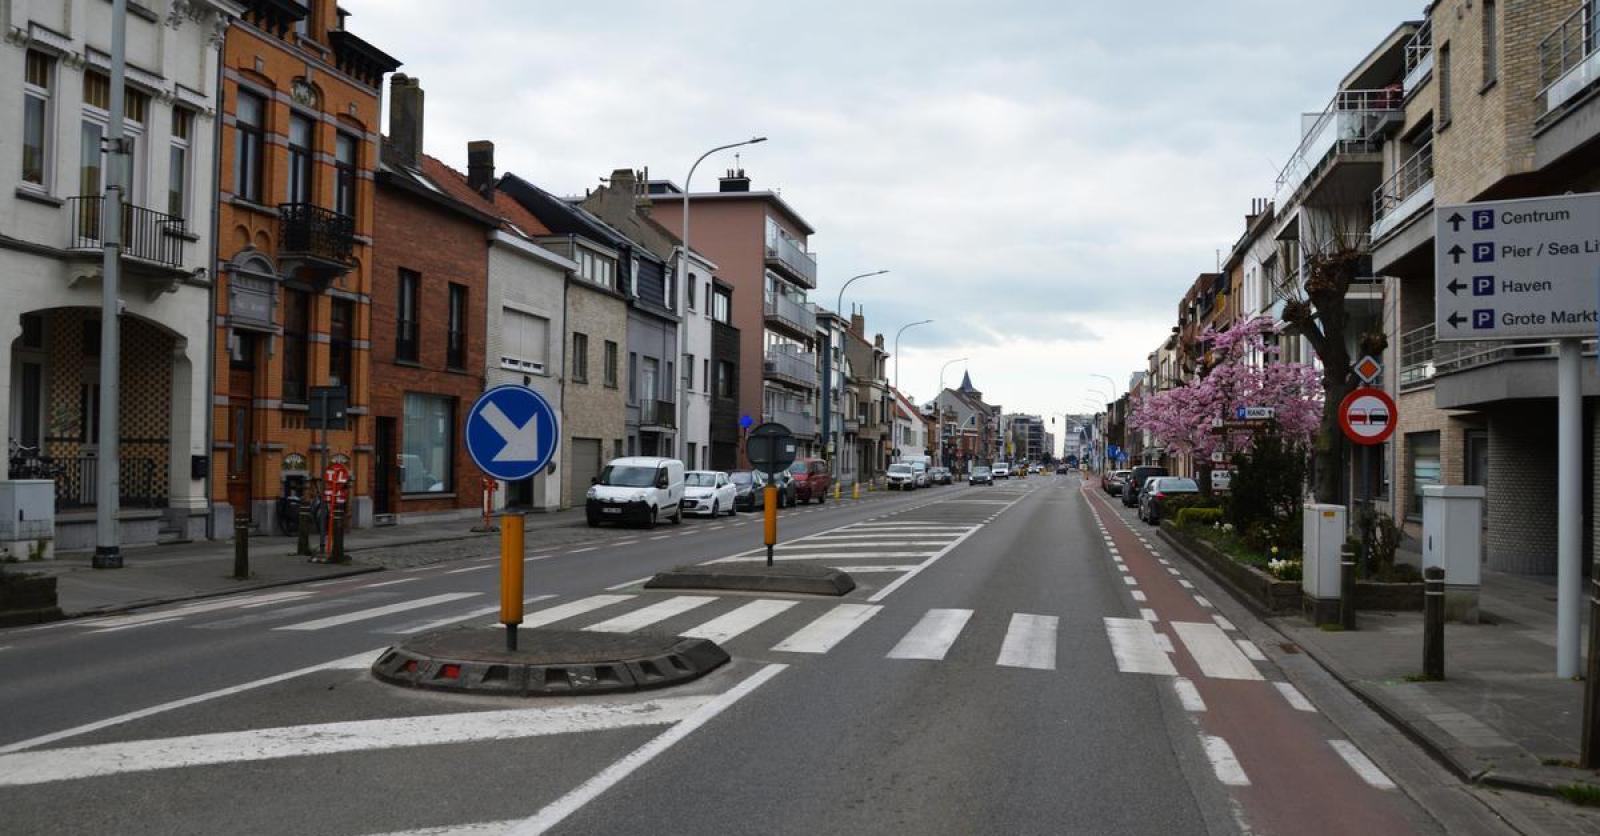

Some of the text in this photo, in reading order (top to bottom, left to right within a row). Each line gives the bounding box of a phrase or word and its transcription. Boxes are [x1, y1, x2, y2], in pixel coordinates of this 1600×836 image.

[1502, 210, 1569, 224] Centrum
[1502, 245, 1533, 258] Pier
[1537, 243, 1545, 256] /
[1548, 242, 1579, 256] Sea
[1584, 239, 1600, 253] Li
[1502, 280, 1552, 293] Haven
[1502, 312, 1545, 326] Grote
[1551, 310, 1599, 324] Markt
[1248, 408, 1266, 417] RAND
